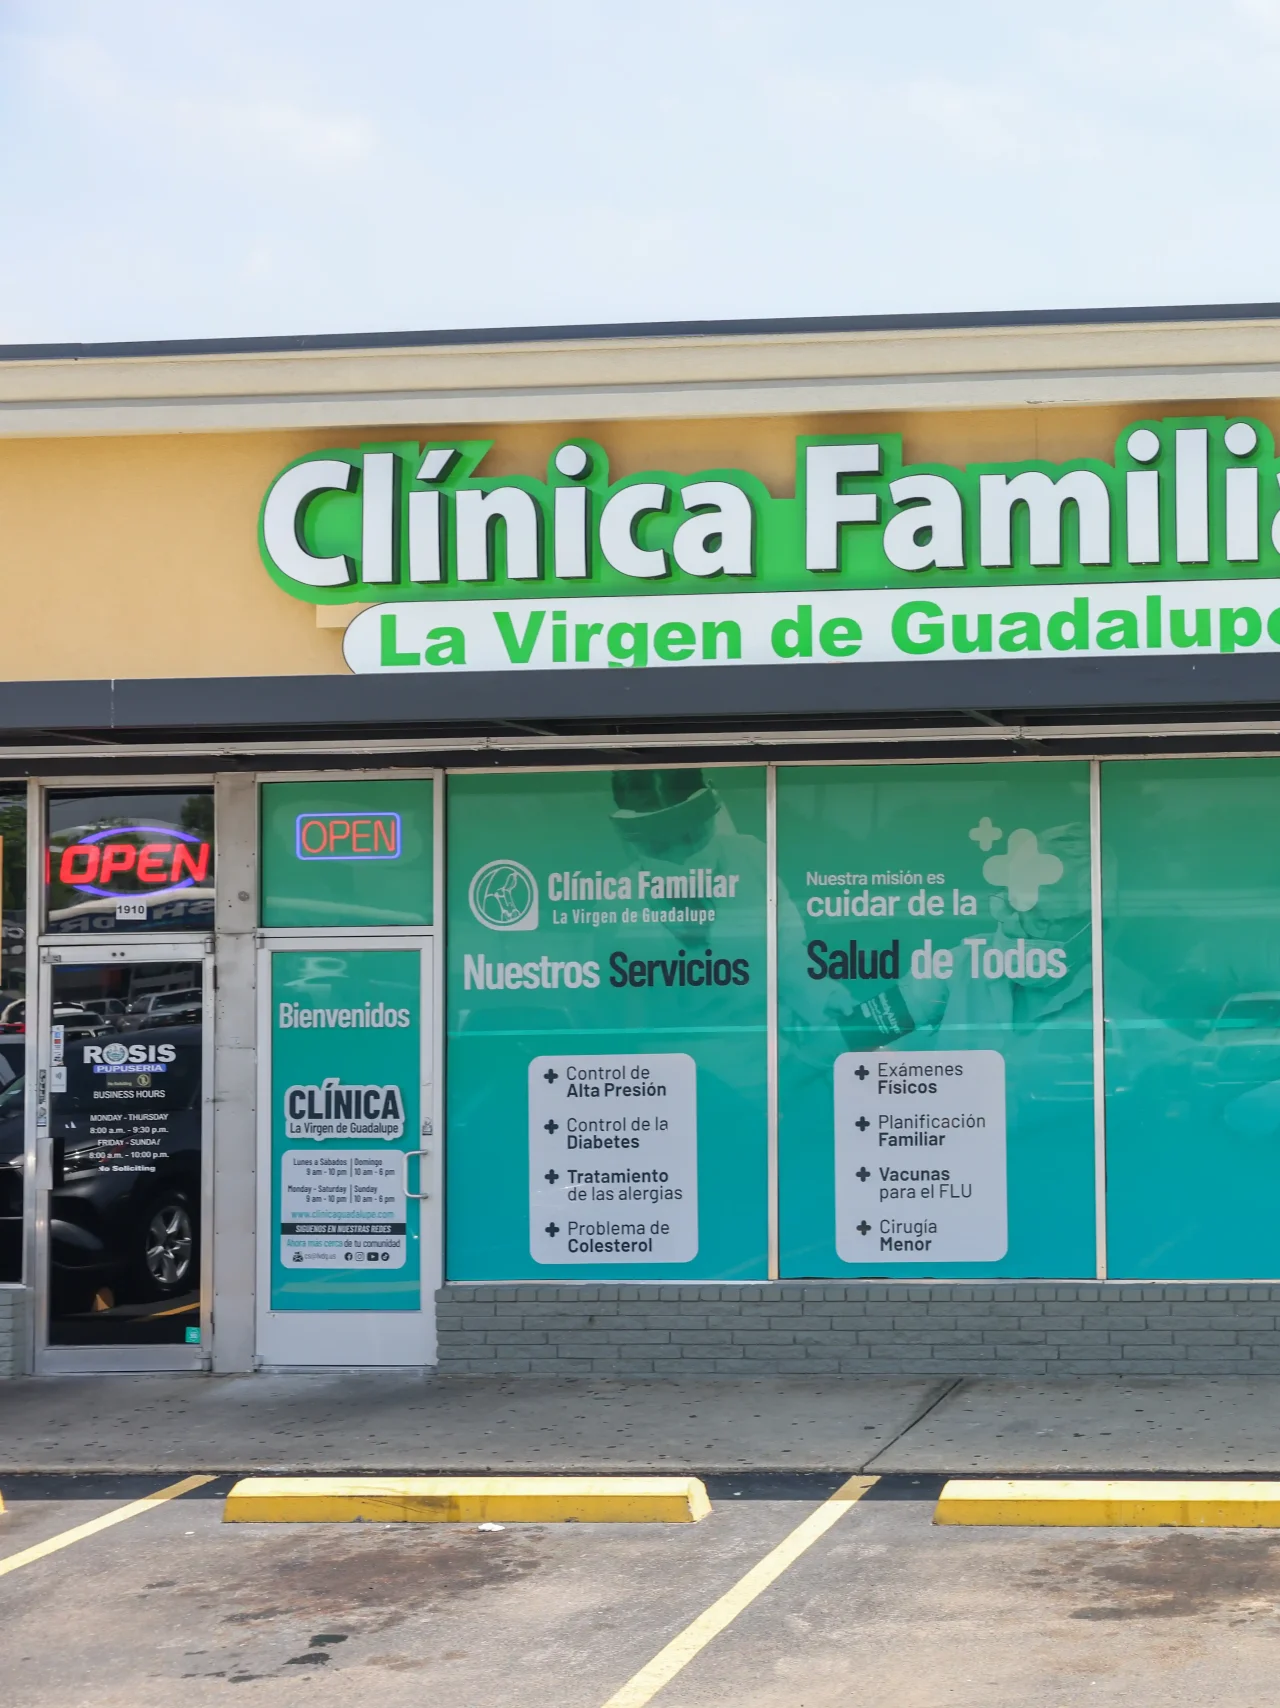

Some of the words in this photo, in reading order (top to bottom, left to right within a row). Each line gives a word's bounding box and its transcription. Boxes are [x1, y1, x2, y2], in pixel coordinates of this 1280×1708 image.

[263, 444, 757, 588] Clínica
[379, 612, 467, 668] La
[492, 608, 743, 670] Virgen
[770, 604, 863, 660] de
[301, 820, 396, 853] OPEN
[59, 843, 210, 884] OPEN
[548, 871, 632, 901] Clínica
[638, 868, 739, 899] Familiar
[806, 871, 868, 886] Nuestra
[871, 868, 923, 885] misión
[926, 871, 945, 885] es
[116, 905, 145, 914] 1910
[806, 889, 900, 917] cuidar
[907, 889, 945, 916] de
[952, 888, 977, 916] la
[553, 909, 568, 925] La
[572, 908, 617, 928] Virgen
[622, 907, 638, 923] de
[642, 905, 716, 924] Guadalupe
[807, 939, 899, 979] Salud
[911, 939, 953, 979] de
[963, 938, 1068, 979] Todos
[463, 952, 600, 990] Nuestros
[608, 948, 750, 988] Servicios
[279, 1001, 410, 1028] Bienvenidos
[83, 1043, 176, 1065] ROSIS
[96, 1065, 163, 1073] PUPUSERIA
[566, 1065, 626, 1080] Control
[630, 1065, 650, 1079] de
[878, 1062, 963, 1077] Exámenes
[566, 1083, 600, 1097] Alta
[604, 1082, 667, 1097] Presión
[878, 1079, 938, 1094] Físicos
[93, 1091, 134, 1099] BUSINESS
[136, 1090, 166, 1098] HOURS
[289, 1083, 400, 1119] CLÍNICA
[290, 1123, 301, 1133] La
[304, 1122, 333, 1136] Virgen
[336, 1122, 347, 1133] de
[350, 1122, 399, 1135] Guadalupe
[567, 1117, 626, 1132] Control
[631, 1117, 650, 1131] de
[655, 1116, 668, 1130] la
[879, 1114, 986, 1129] Planificación
[567, 1134, 640, 1149] Diabetes
[879, 1131, 946, 1146] Familiar
[354, 1158, 382, 1167] Domingo
[337, 1169, 347, 1177] pm
[385, 1169, 395, 1177] pm
[567, 1168, 669, 1184] Tratamiento
[879, 1167, 950, 1181] Vacunas
[288, 1185, 311, 1194] Monday
[318, 1185, 347, 1194] Saturday
[354, 1185, 378, 1194] Sunday
[567, 1187, 587, 1201] de
[592, 1186, 614, 1200] las
[618, 1185, 683, 1203] alergias
[880, 1187, 916, 1202] para
[920, 1183, 934, 1198] el
[939, 1183, 972, 1198] FLU
[336, 1196, 347, 1204] pm
[385, 1196, 395, 1204] pm
[291, 1210, 395, 1220] www.clinicaguadalupe.com
[327, 1225, 337, 1233] EN
[337, 1225, 371, 1233] NUESTRAS
[370, 1225, 392, 1233] REDES
[568, 1220, 646, 1235] Problema
[650, 1220, 670, 1235] de
[880, 1219, 937, 1237] Cirugía
[286, 1239, 306, 1247] Ahora
[363, 1239, 400, 1248] comunidad
[568, 1238, 653, 1252] Colesterol
[880, 1237, 932, 1251] Menor
